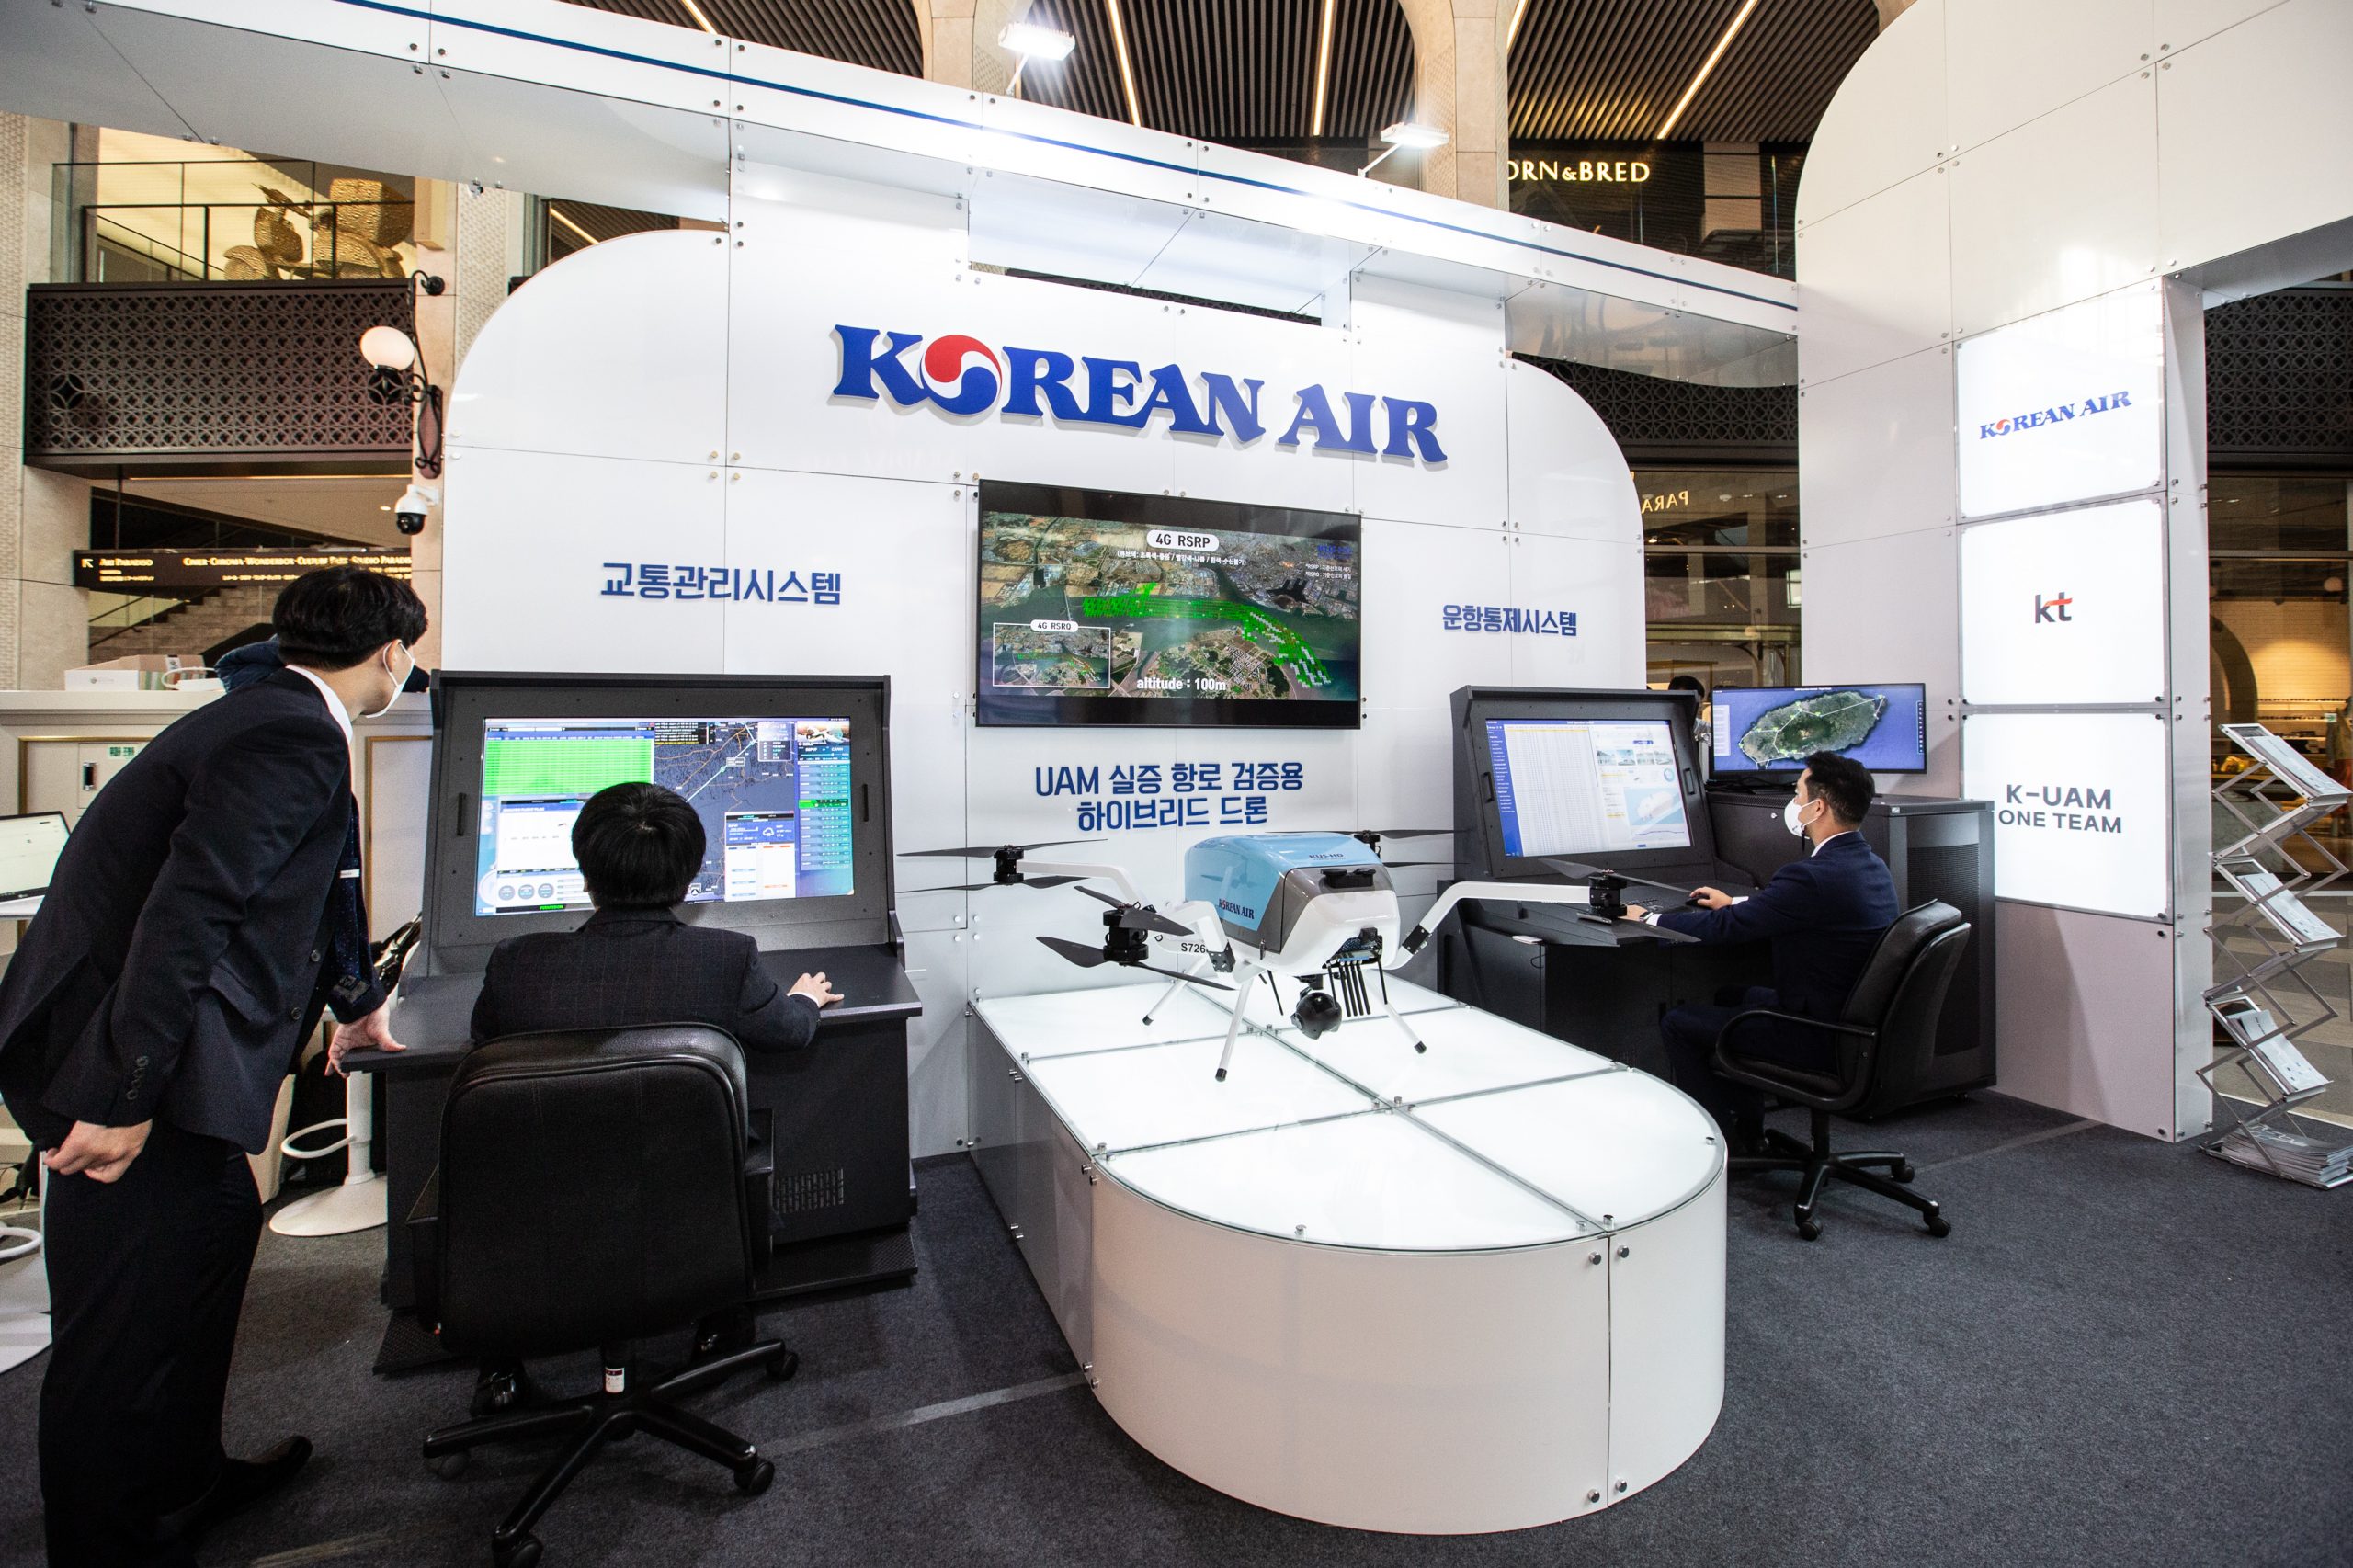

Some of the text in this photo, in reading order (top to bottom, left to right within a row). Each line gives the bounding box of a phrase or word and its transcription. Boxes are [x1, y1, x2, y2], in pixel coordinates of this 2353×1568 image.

[833, 324, 1449, 464] KOREAN AIR
[1979, 390, 2133, 440] KOREAN AIR
[1155, 533, 1211, 549] 4G RSRP
[600, 562, 841, 605] 교통관리시스템
[1442, 604, 1577, 637] 운항통제시스템
[2034, 591, 2073, 624] kt
[1037, 621, 1072, 631] 4G RSRQ
[1136, 677, 1184, 690] altitude
[1194, 678, 1226, 690] 100m
[1035, 762, 1303, 797] UAM 실증 항로 검증용
[2006, 784, 2112, 810] K-UAM
[1076, 796, 1268, 832] 하이브리드 드론
[1998, 809, 2122, 834] ONE TEAM
[1218, 898, 1256, 919] KOREAN AIR
